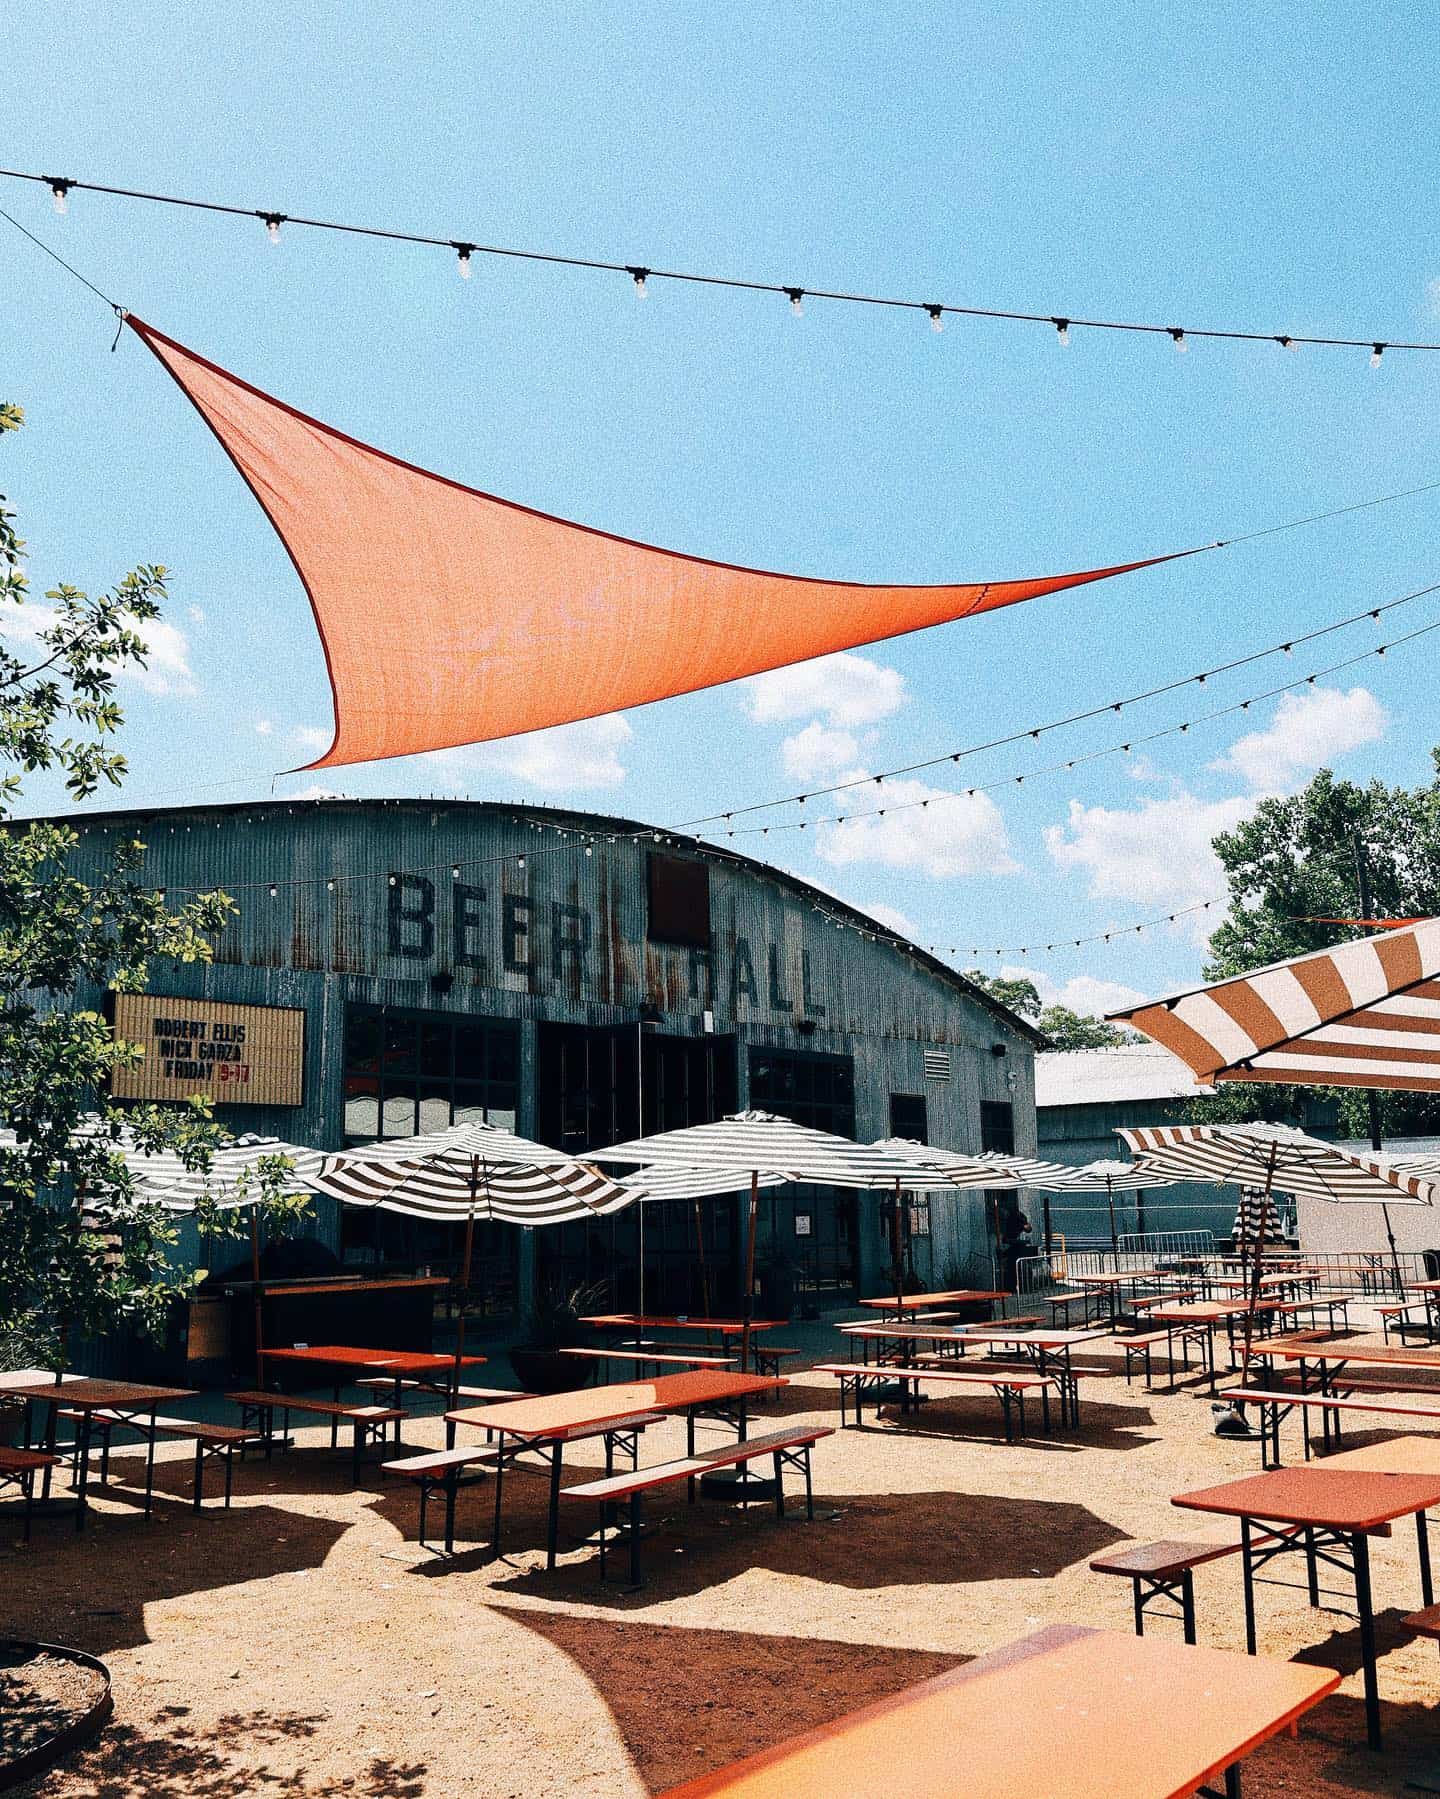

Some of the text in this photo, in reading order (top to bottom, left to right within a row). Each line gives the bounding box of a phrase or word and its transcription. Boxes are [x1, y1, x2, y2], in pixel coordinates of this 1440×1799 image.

[388, 872, 592, 984] BEER
[154, 1018, 246, 1042] ROBERT ELLIS
[160, 1040, 241, 1062] NICK GARZA
[165, 1060, 213, 1080] FRIDAY
